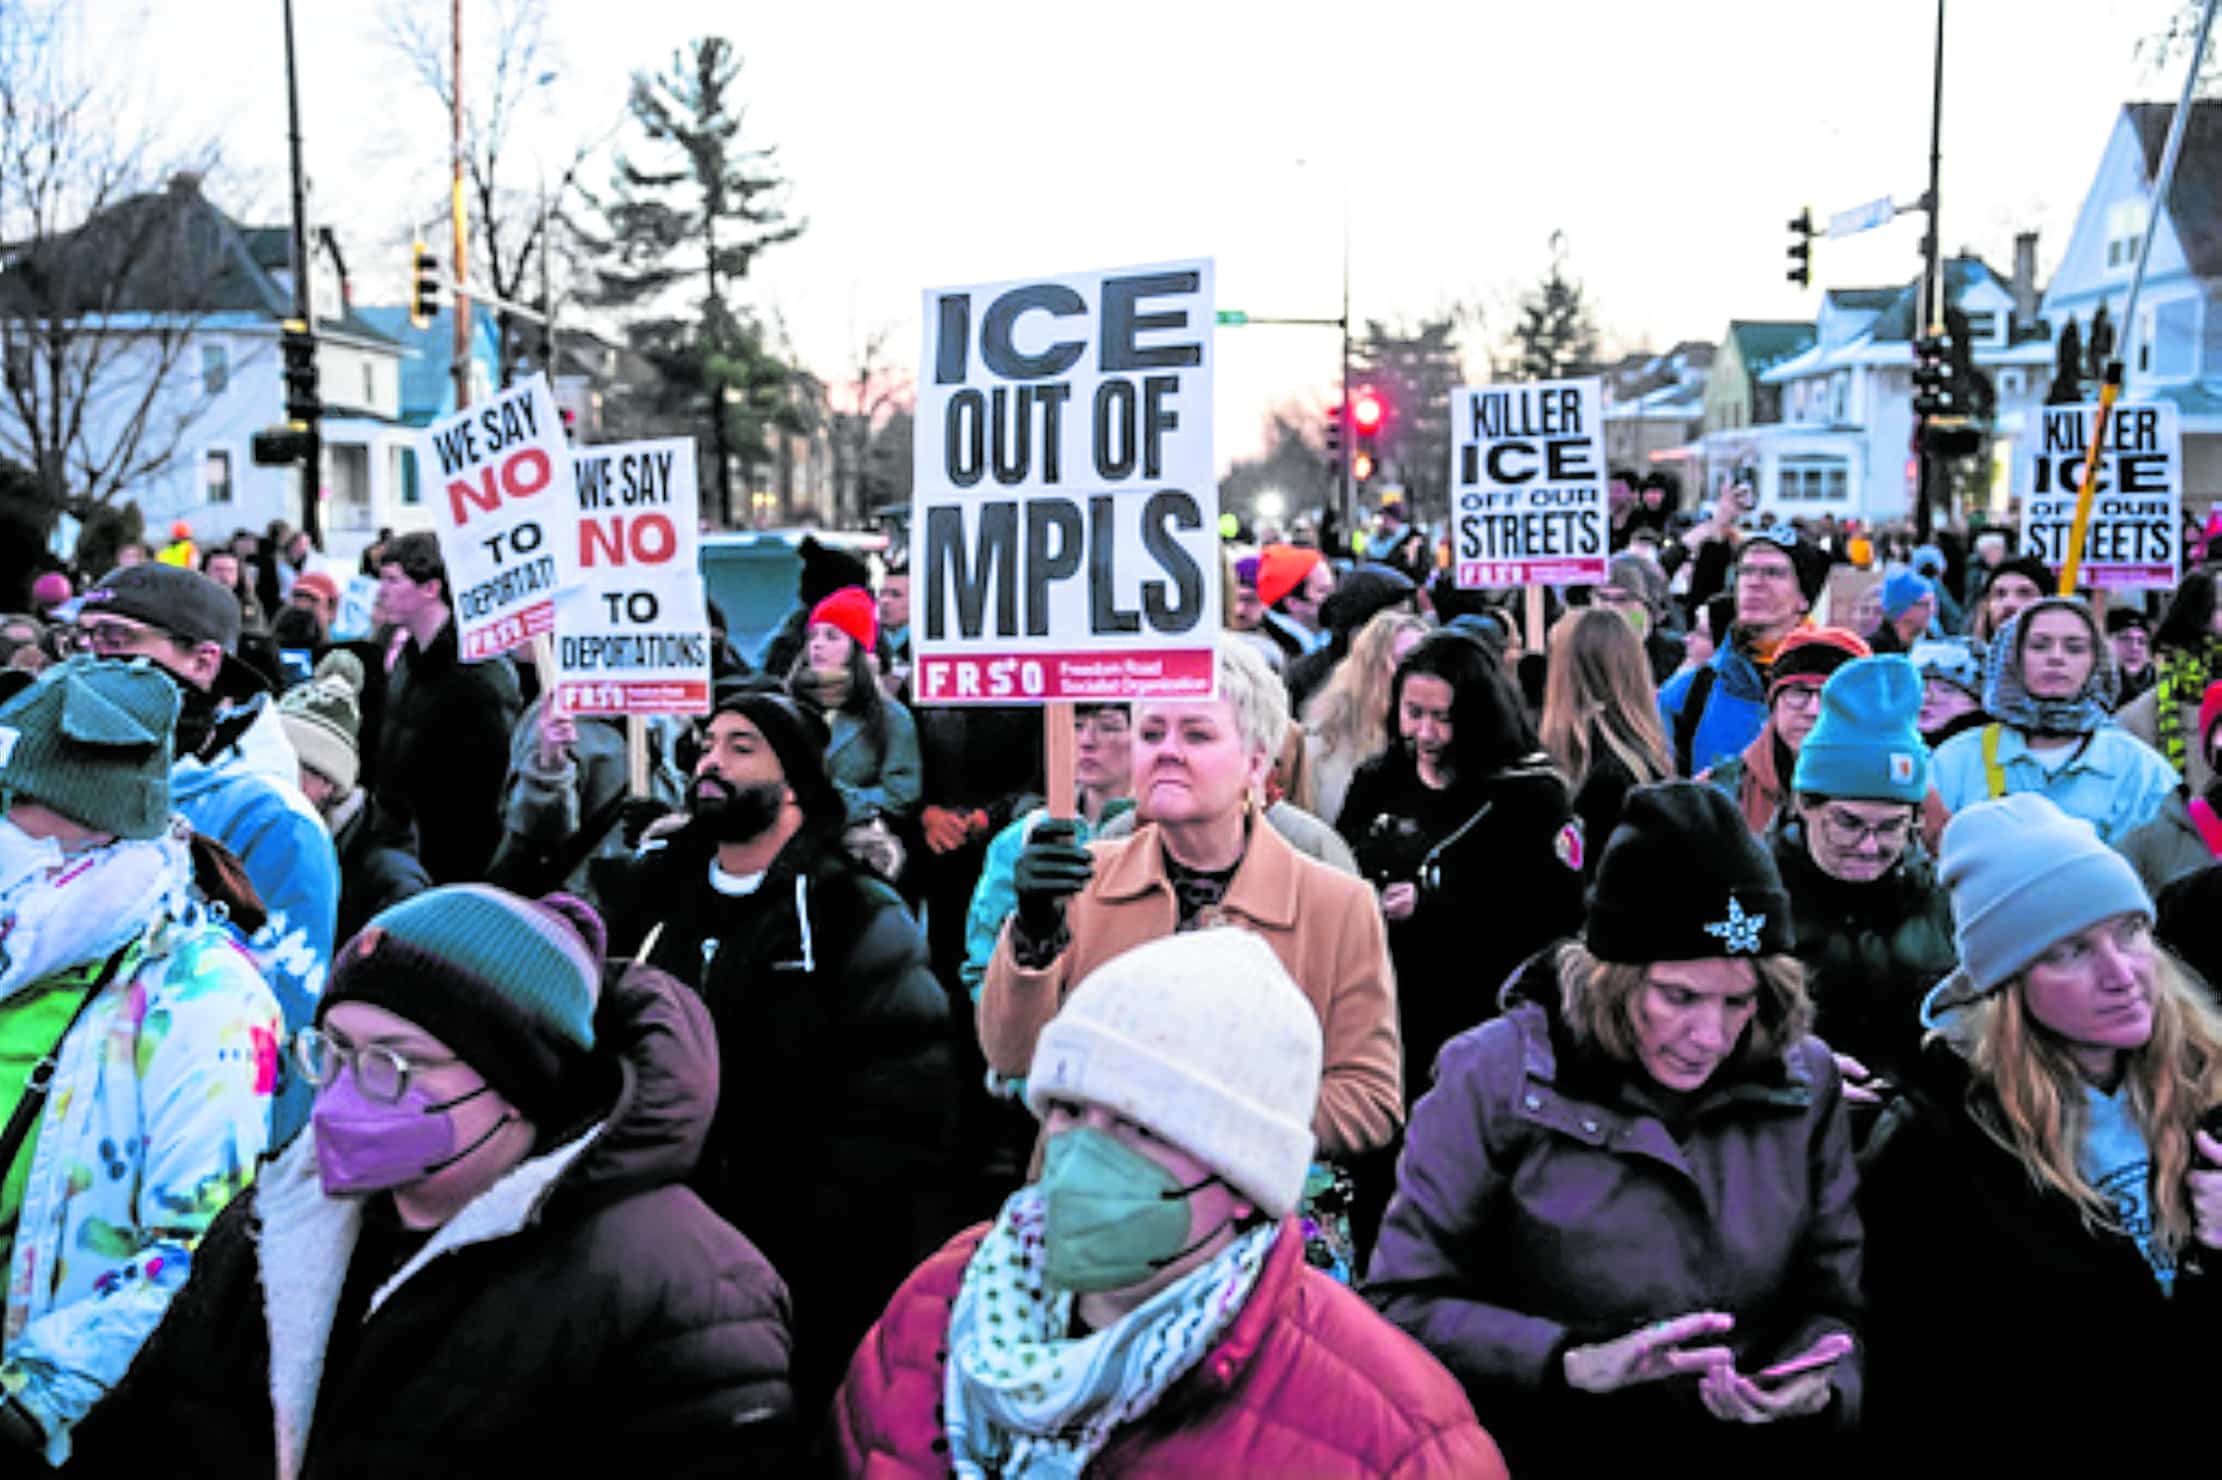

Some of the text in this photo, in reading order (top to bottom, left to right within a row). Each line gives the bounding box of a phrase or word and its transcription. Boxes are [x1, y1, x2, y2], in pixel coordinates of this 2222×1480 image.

[935, 271, 1203, 384] ICE
[432, 391, 540, 476] WE SAY
[945, 375, 1179, 488] OUT OF
[1470, 388, 1582, 438] KILLER
[574, 451, 673, 510] WE SAY
[1461, 437, 1597, 485] ICE
[2034, 454, 2169, 494] ICE
[446, 448, 551, 526] NO
[1461, 486, 1598, 511] OFF OUR
[2030, 500, 2084, 516] OF
[483, 522, 542, 565] TO
[579, 513, 677, 568] NO
[1461, 510, 1600, 559] STREETS
[2029, 520, 2170, 561] STEETS
[925, 488, 1204, 640] MPLS
[602, 592, 659, 624] TO
[561, 633, 707, 670] DEPORTATIONS
